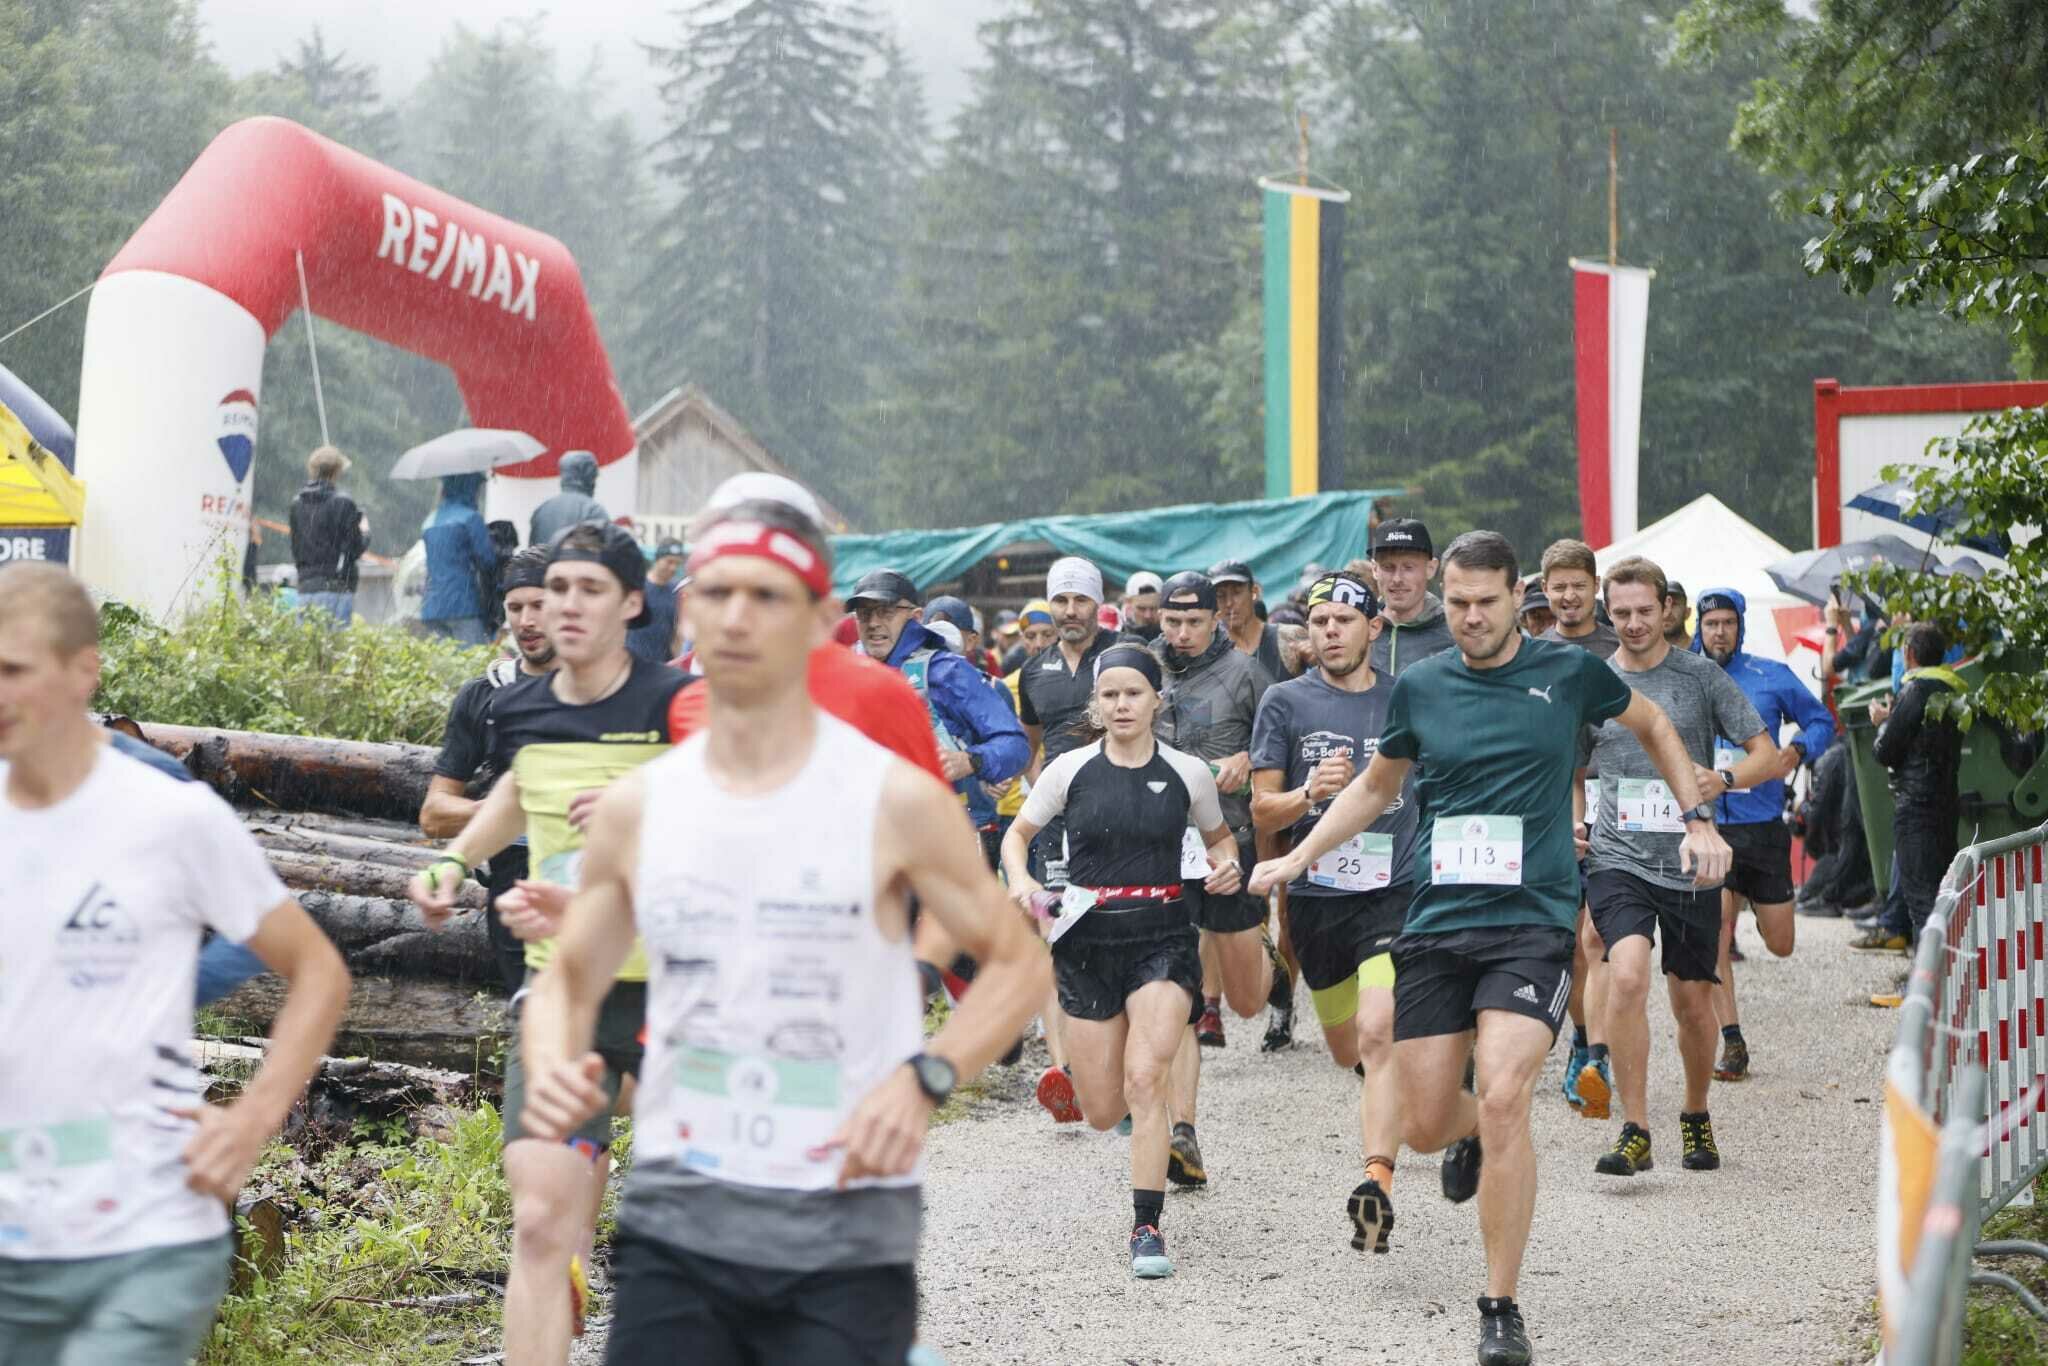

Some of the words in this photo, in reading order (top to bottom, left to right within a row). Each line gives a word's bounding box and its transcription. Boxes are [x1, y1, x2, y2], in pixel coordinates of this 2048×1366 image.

[377, 191, 540, 321] RE/MAX
[1641, 803, 1671, 819] 114
[1337, 856, 1361, 876] 25
[1459, 846, 1497, 866] 113
[732, 1112, 774, 1149] 10
